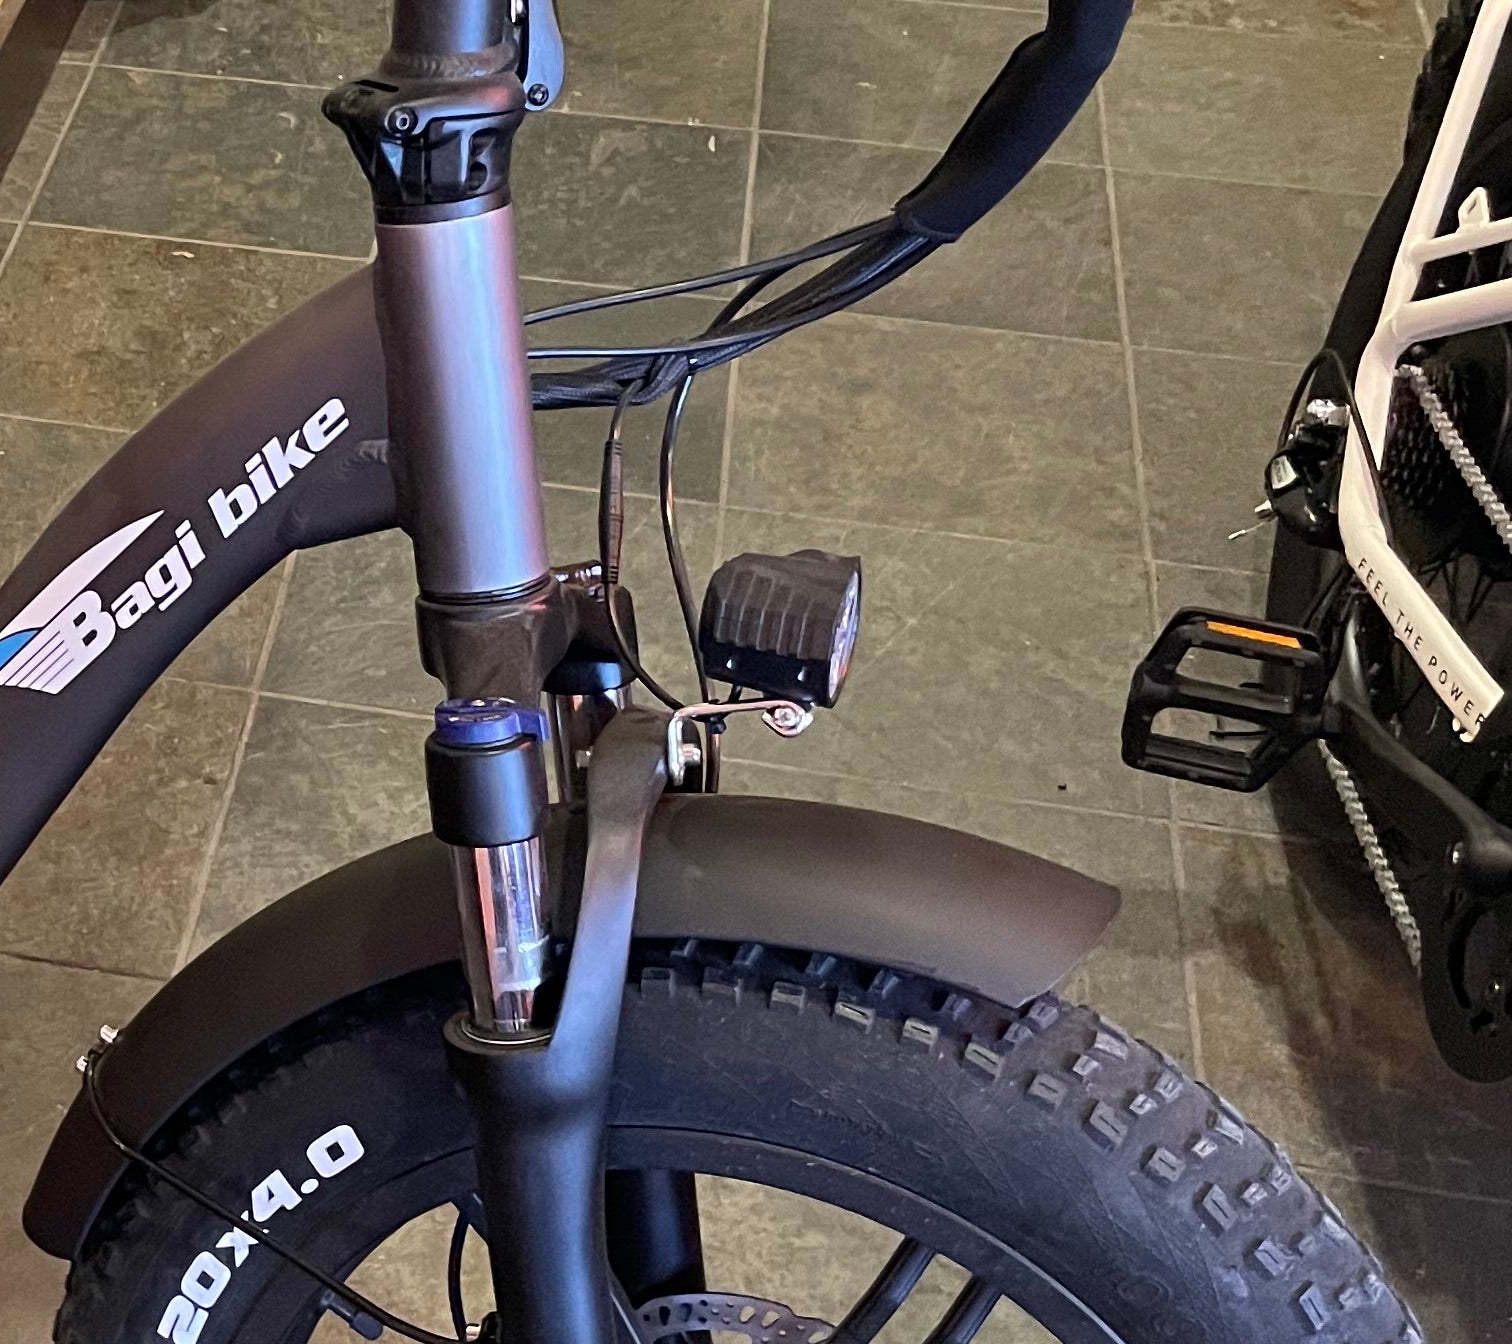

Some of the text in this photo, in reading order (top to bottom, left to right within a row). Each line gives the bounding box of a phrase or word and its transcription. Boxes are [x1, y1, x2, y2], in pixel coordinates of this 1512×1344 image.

[33, 398, 350, 681] Bagi bike
[1358, 558, 1487, 726] FEEL THE POWER
